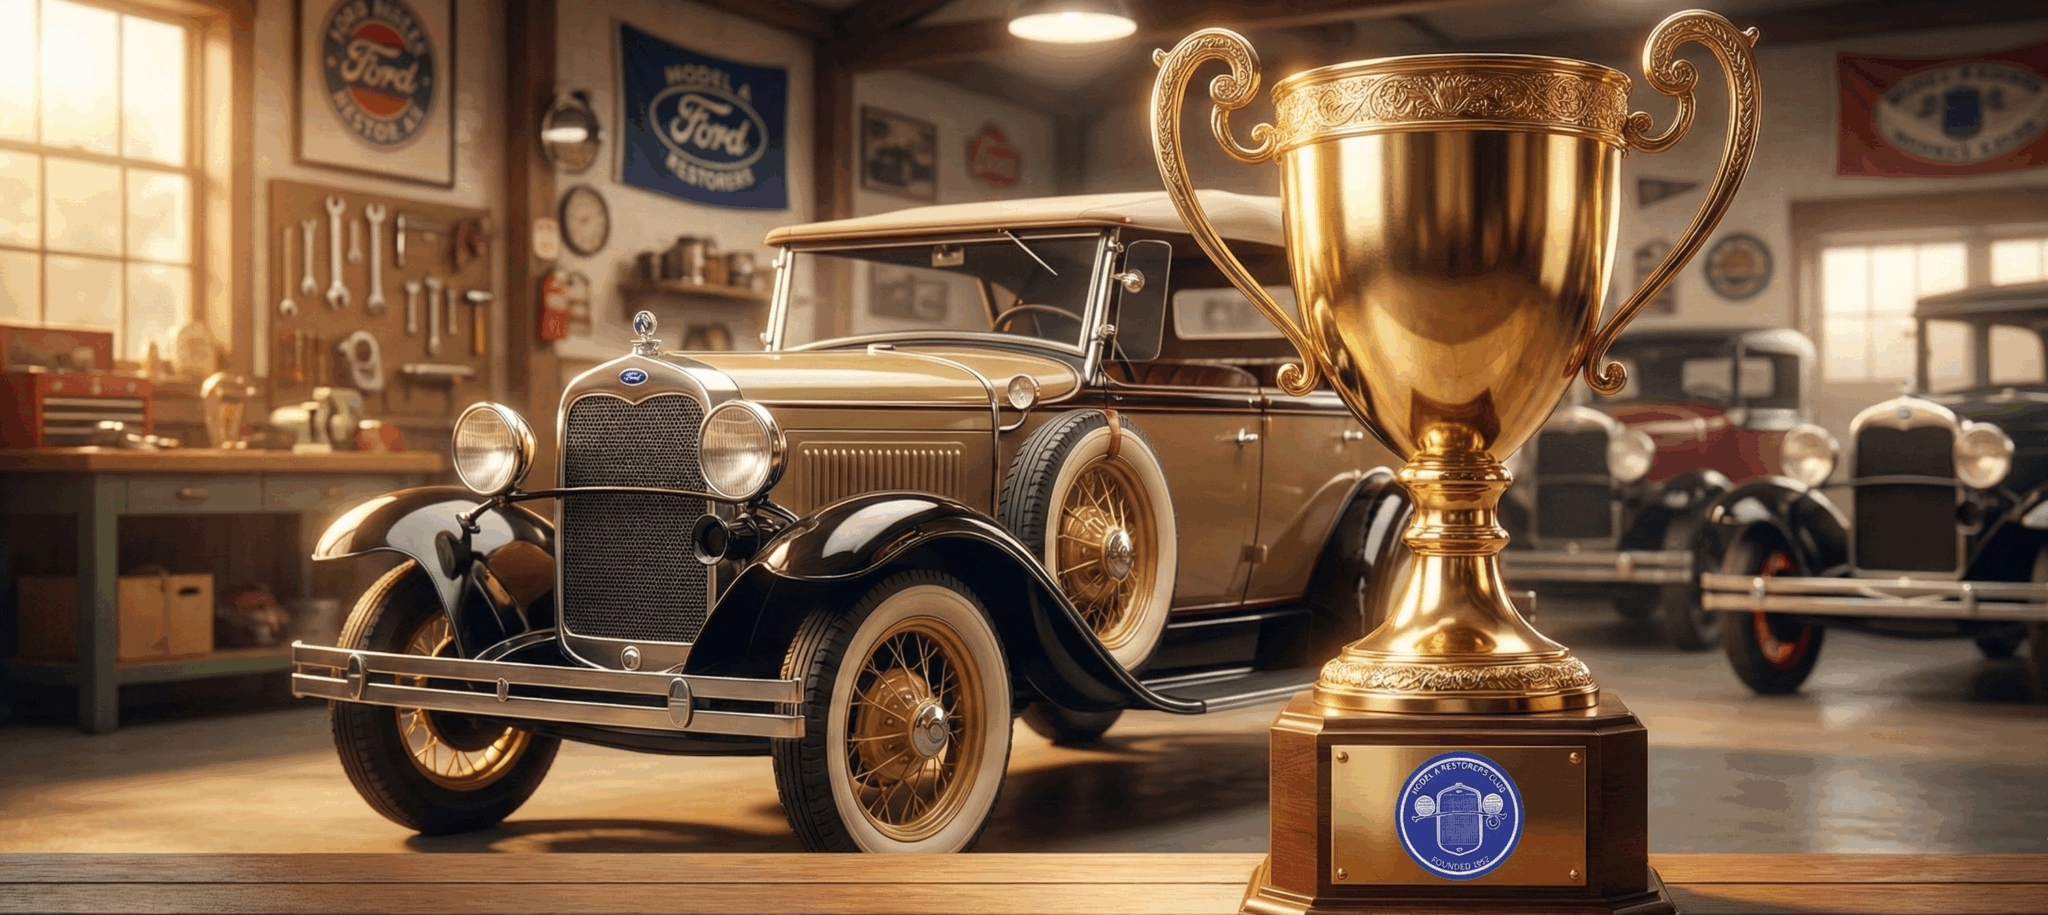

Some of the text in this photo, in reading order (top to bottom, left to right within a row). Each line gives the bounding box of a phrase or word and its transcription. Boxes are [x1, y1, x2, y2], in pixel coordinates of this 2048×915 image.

[340, 38, 419, 94] Ford
[664, 63, 752, 105] MODEL A
[669, 93, 751, 156] Ford
[665, 151, 756, 192] RESTORERS
[1411, 772, 1435, 795] MODEL
[1434, 768, 1441, 776] A
[1441, 761, 1489, 777] RESTORERS
[1431, 856, 1490, 871] FOUNDED 1952
